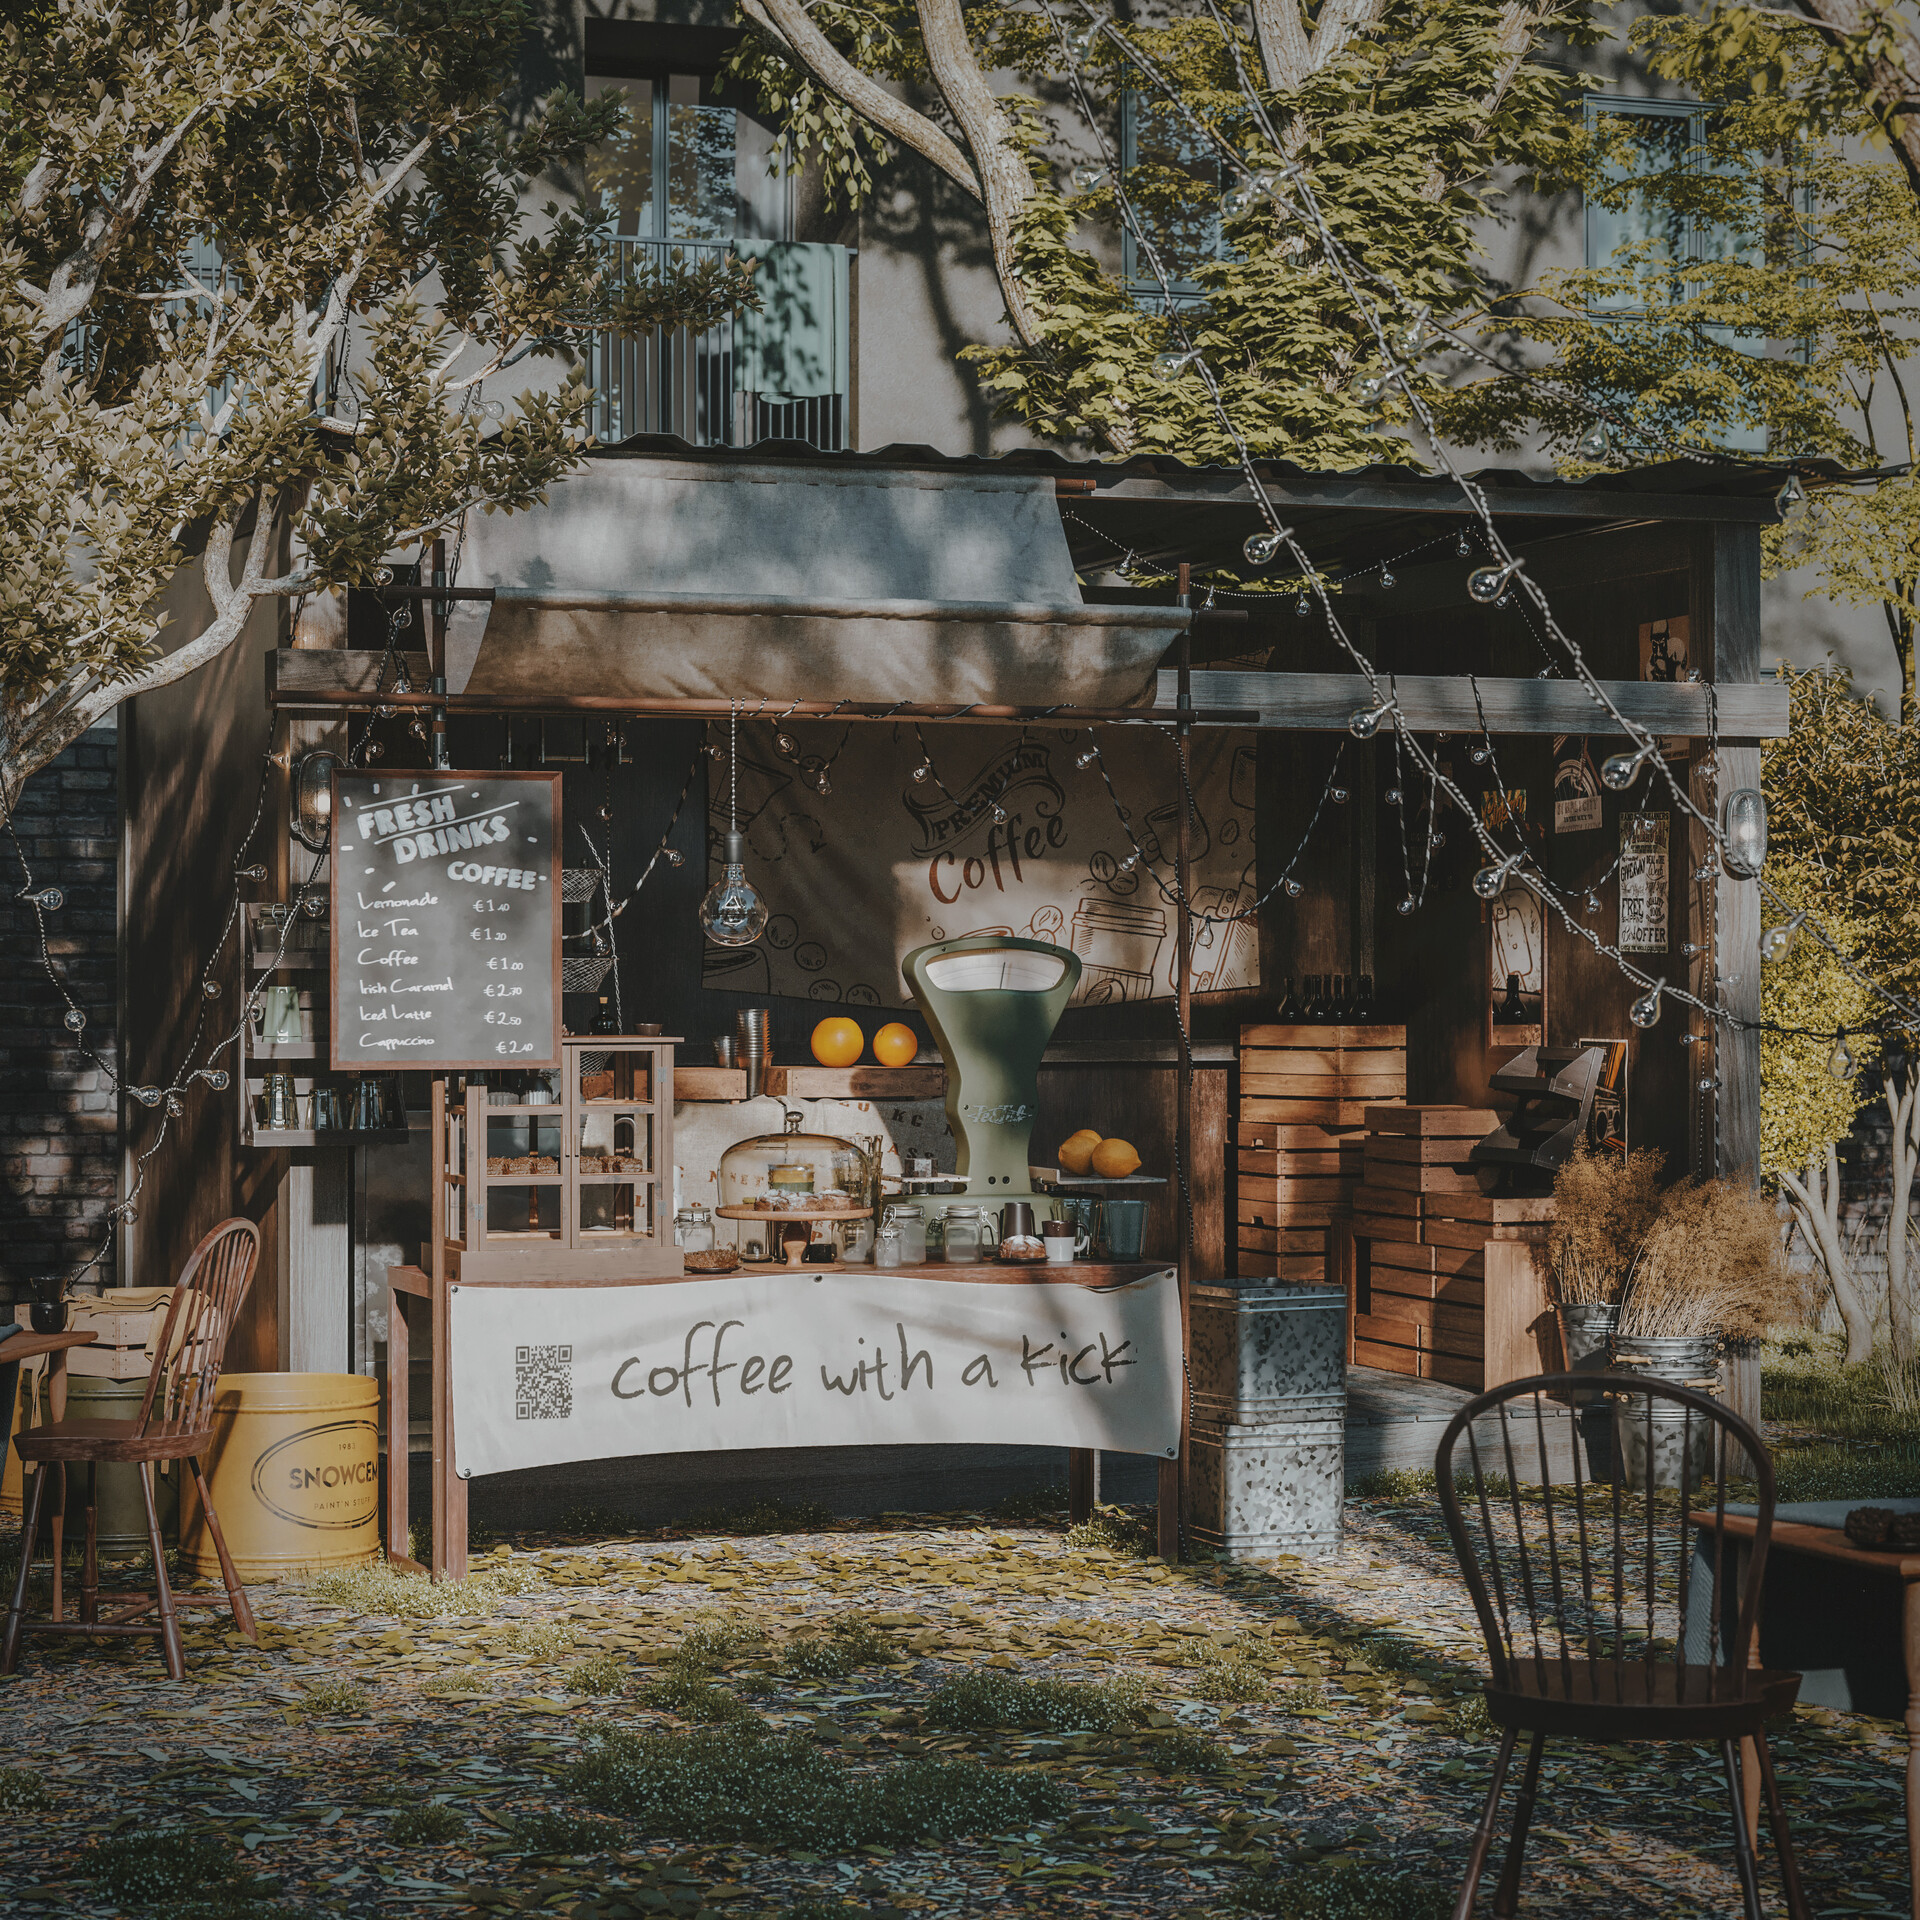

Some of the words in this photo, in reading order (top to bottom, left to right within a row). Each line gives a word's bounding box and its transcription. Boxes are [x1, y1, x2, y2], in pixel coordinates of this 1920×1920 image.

[932, 753, 1045, 841] PREMIUM
[356, 795, 456, 840] FRESH
[392, 815, 511, 864] DRINKS
[929, 813, 1068, 904] Coffee
[447, 861, 537, 891] COFFEE
[1621, 857, 1646, 881] GIVEAWAY
[357, 892, 439, 910] Lemonade
[1622, 897, 1644, 917] FREE
[357, 921, 379, 938] Ice
[384, 918, 419, 937] Tea
[1636, 928, 1666, 943] OFFER
[357, 948, 419, 967] Coffee
[359, 979, 387, 995] Irish
[390, 977, 454, 994] Caramel
[359, 1006, 387, 1021] Iced
[391, 1004, 432, 1020] Latte
[359, 1032, 435, 1051] Cappuccino
[611, 1320, 793, 1408] coffee
[820, 1322, 934, 1401] with
[962, 1356, 998, 1388] a
